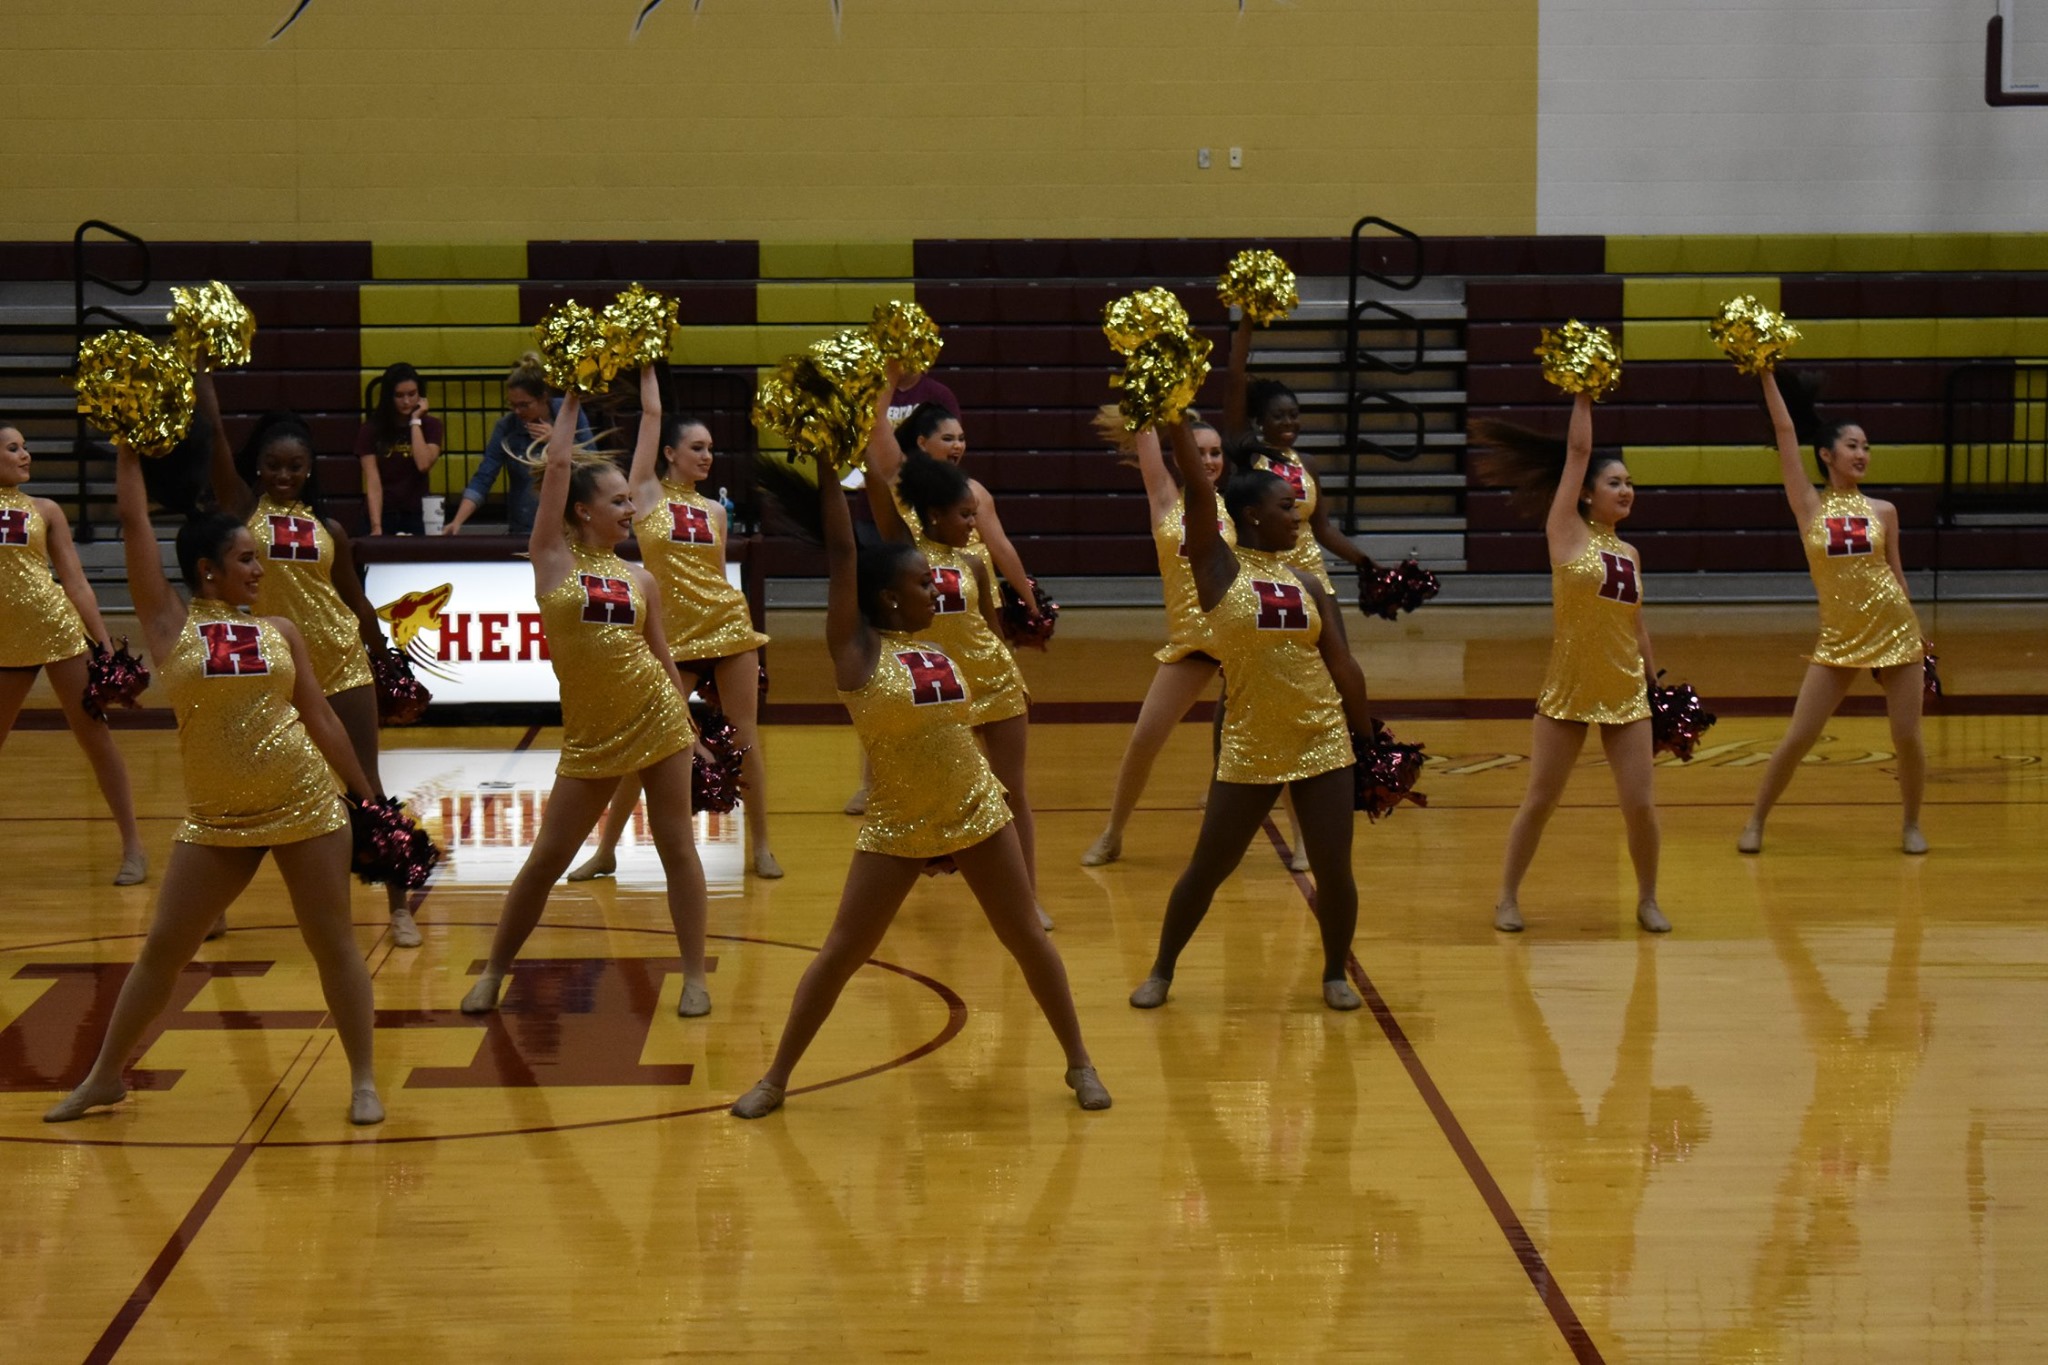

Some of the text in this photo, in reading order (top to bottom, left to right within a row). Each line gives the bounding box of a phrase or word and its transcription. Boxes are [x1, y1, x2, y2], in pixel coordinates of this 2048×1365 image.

[267, 514, 319, 562] H
[667, 501, 714, 546] H
[1825, 516, 1882, 557] H
[580, 574, 636, 625] H
[1598, 550, 1640, 605] H
[1252, 580, 1309, 631] H
[198, 621, 269, 677] H
[436, 611, 551, 662] HER
[895, 650, 966, 706] H
